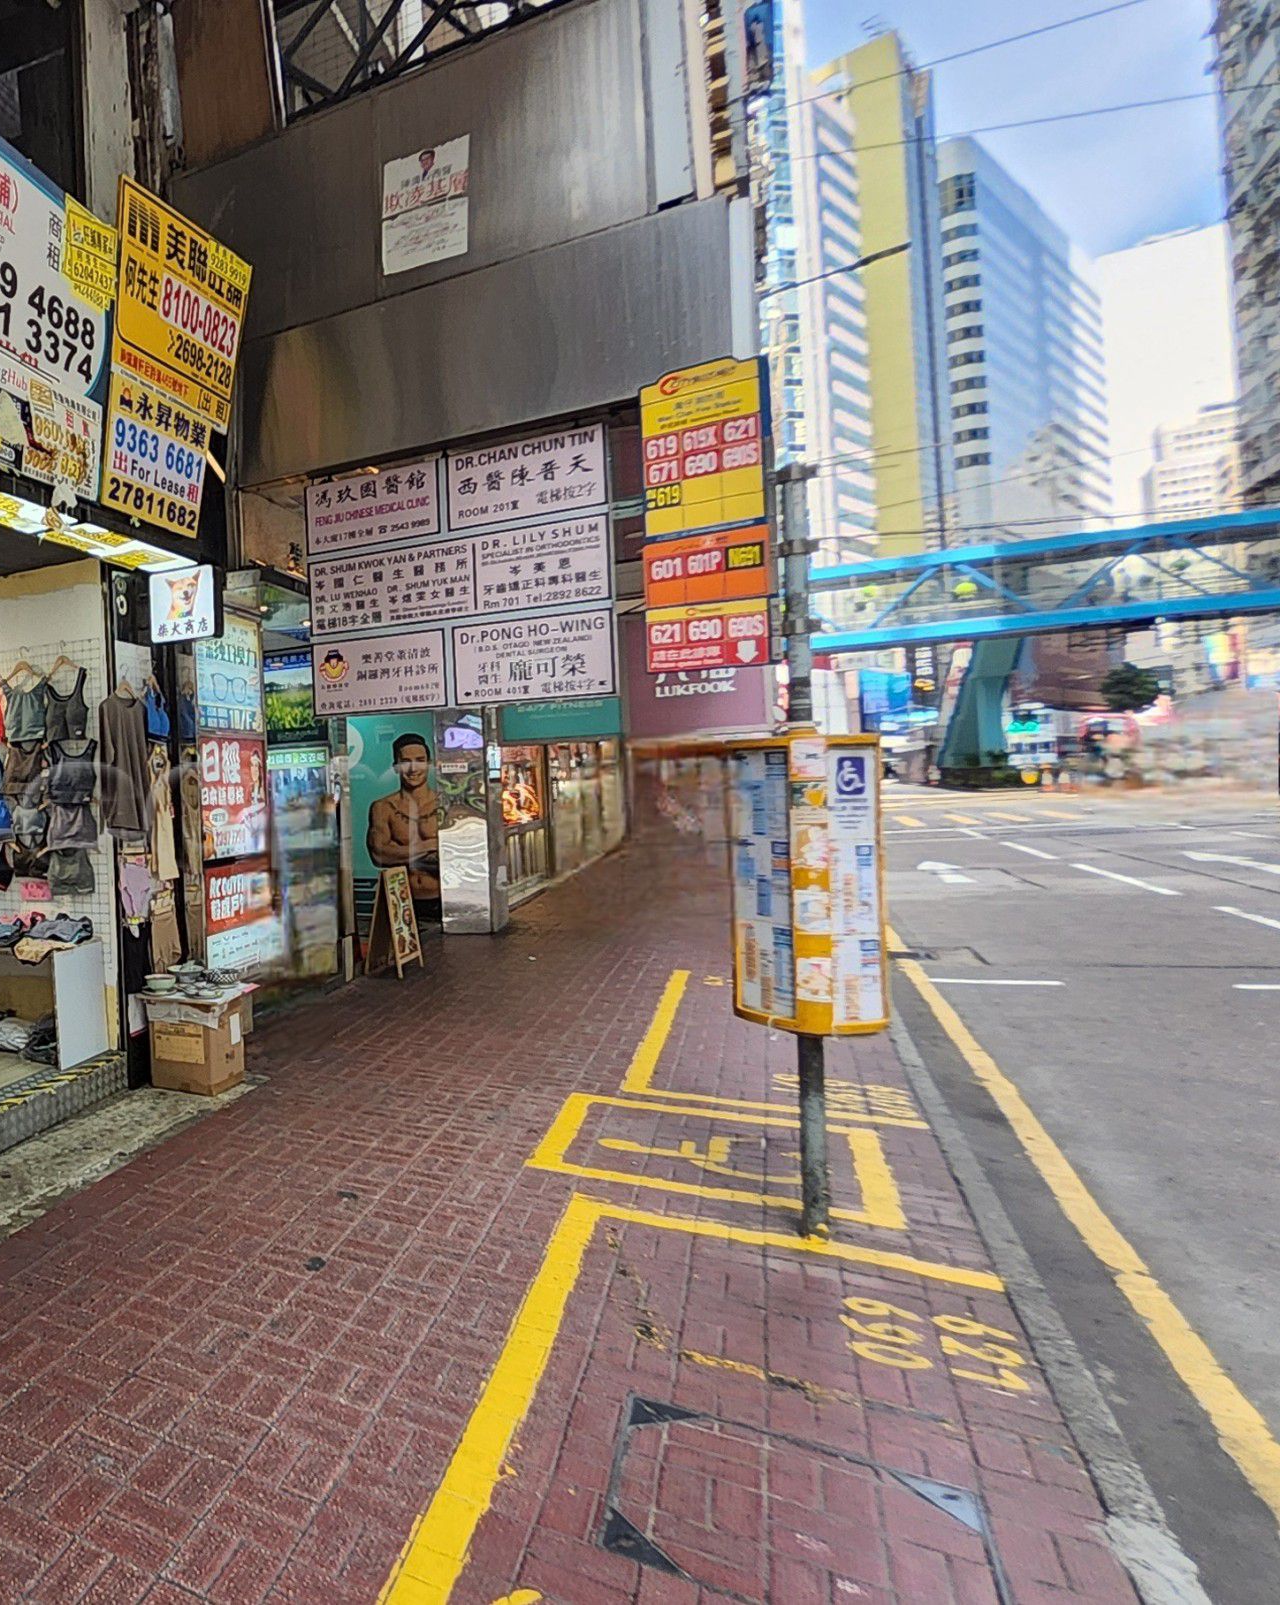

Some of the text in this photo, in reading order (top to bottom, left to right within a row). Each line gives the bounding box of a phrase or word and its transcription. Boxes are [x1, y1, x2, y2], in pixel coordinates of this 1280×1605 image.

[26, 284, 96, 352] 4688
[161, 276, 238, 359] 8100-0823
[25, 318, 94, 385] 3374
[174, 332, 233, 390] 2698-2128
[135, 391, 207, 450] 永昇物業
[114, 417, 160, 464] 9363
[164, 438, 205, 484] 6681
[454, 428, 597, 472] DR.CHAN CHUN TIN
[645, 434, 679, 460] 619
[723, 416, 757, 443] 621
[130, 458, 186, 499] For Lease
[648, 460, 679, 485] 671
[107, 476, 198, 532] 27811682
[345, 505, 375, 521] CHINESE
[375, 499, 406, 515] MEDICAL
[406, 495, 431, 510] CLINIC
[457, 505, 489, 520] ROOM
[481, 522, 600, 552] DR. LILY SHUM
[329, 561, 357, 576] SHUM
[357, 556, 386, 571] KWOK
[386, 553, 408, 566] YAN
[408, 552, 416, 563] &
[416, 543, 468, 561] PARTNERS
[650, 557, 683, 581] 601
[431, 576, 449, 588] YUK
[450, 573, 471, 586] MAN
[482, 599, 501, 610] Rm
[501, 595, 521, 607] 701
[460, 615, 606, 646] Dr.PONG HO-WING
[650, 623, 682, 645] 621
[687, 618, 722, 642] 690
[473, 687, 503, 698] ROOM
[655, 680, 738, 699] LUKFOOK
